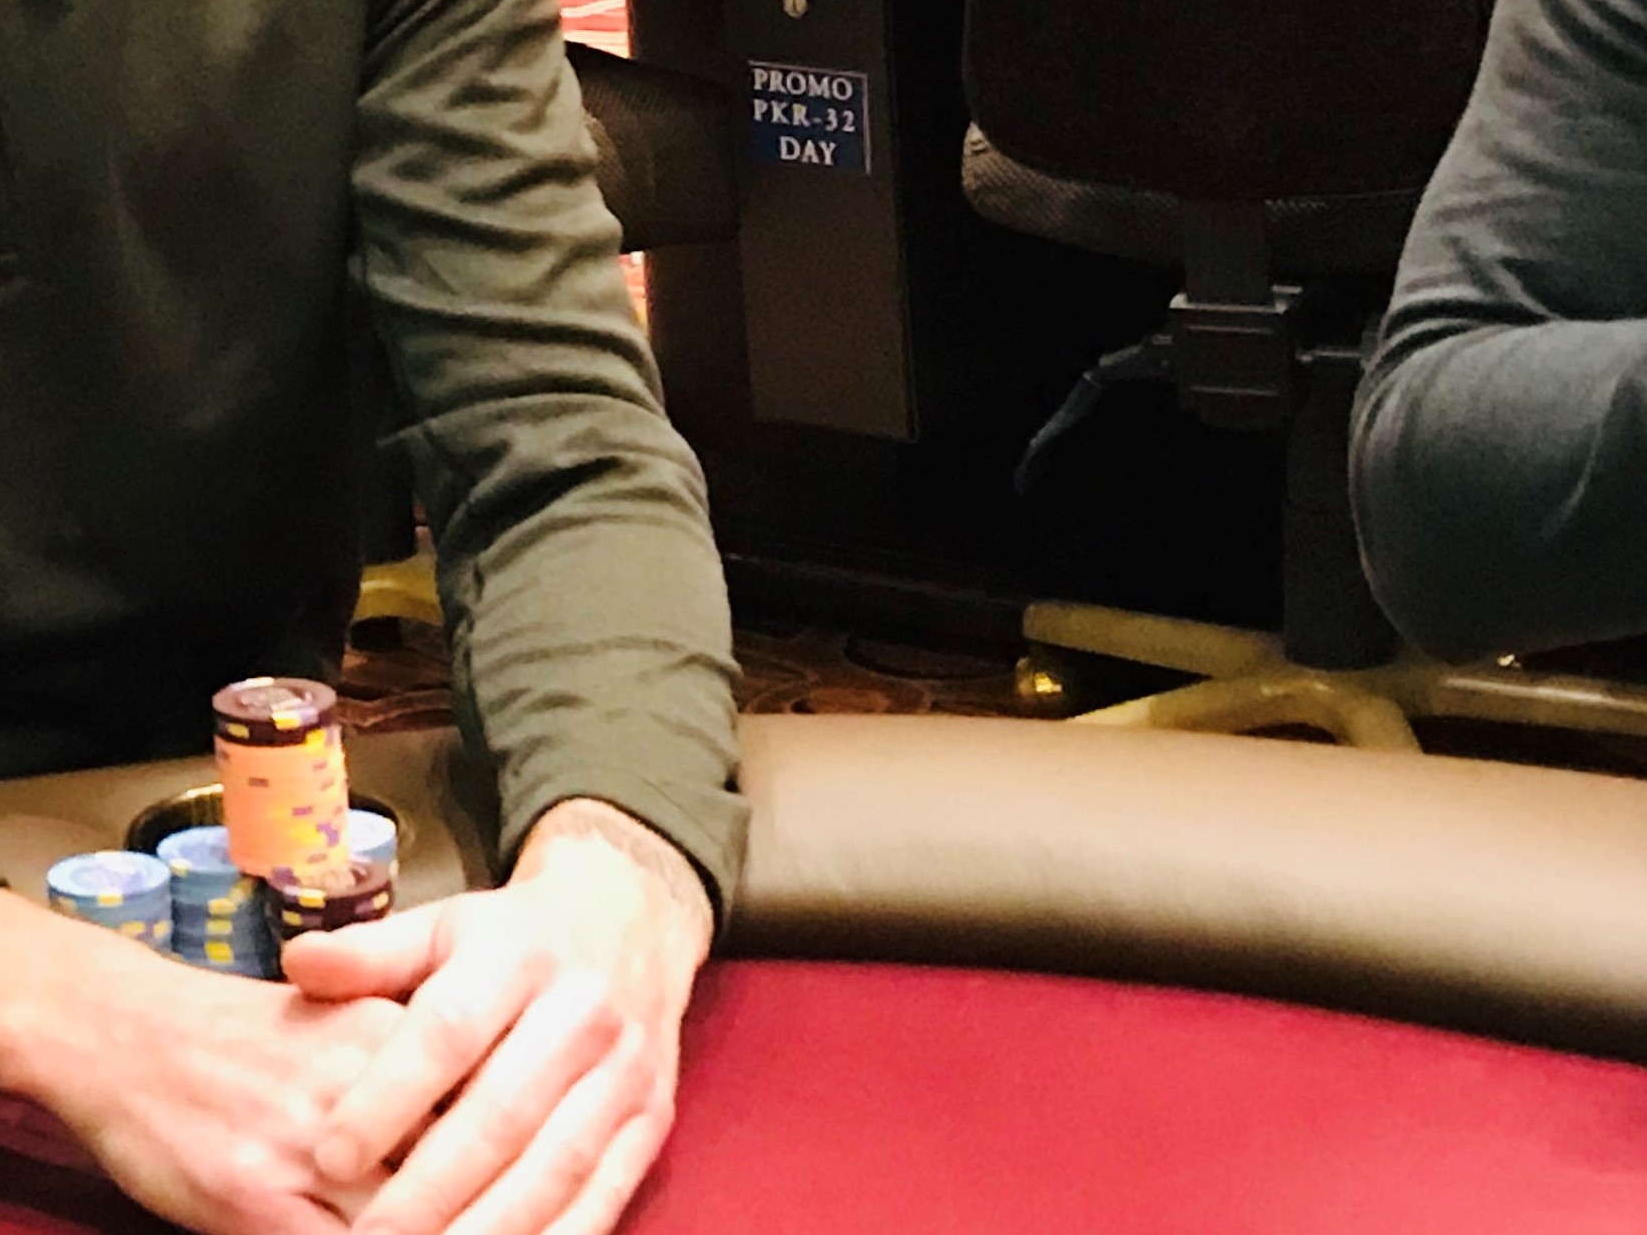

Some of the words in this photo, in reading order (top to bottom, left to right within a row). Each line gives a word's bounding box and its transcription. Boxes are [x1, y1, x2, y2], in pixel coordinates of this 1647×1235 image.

[753, 68, 853, 100] PROMO
[753, 98, 855, 132] PKR-32
[780, 136, 836, 165] DAY
